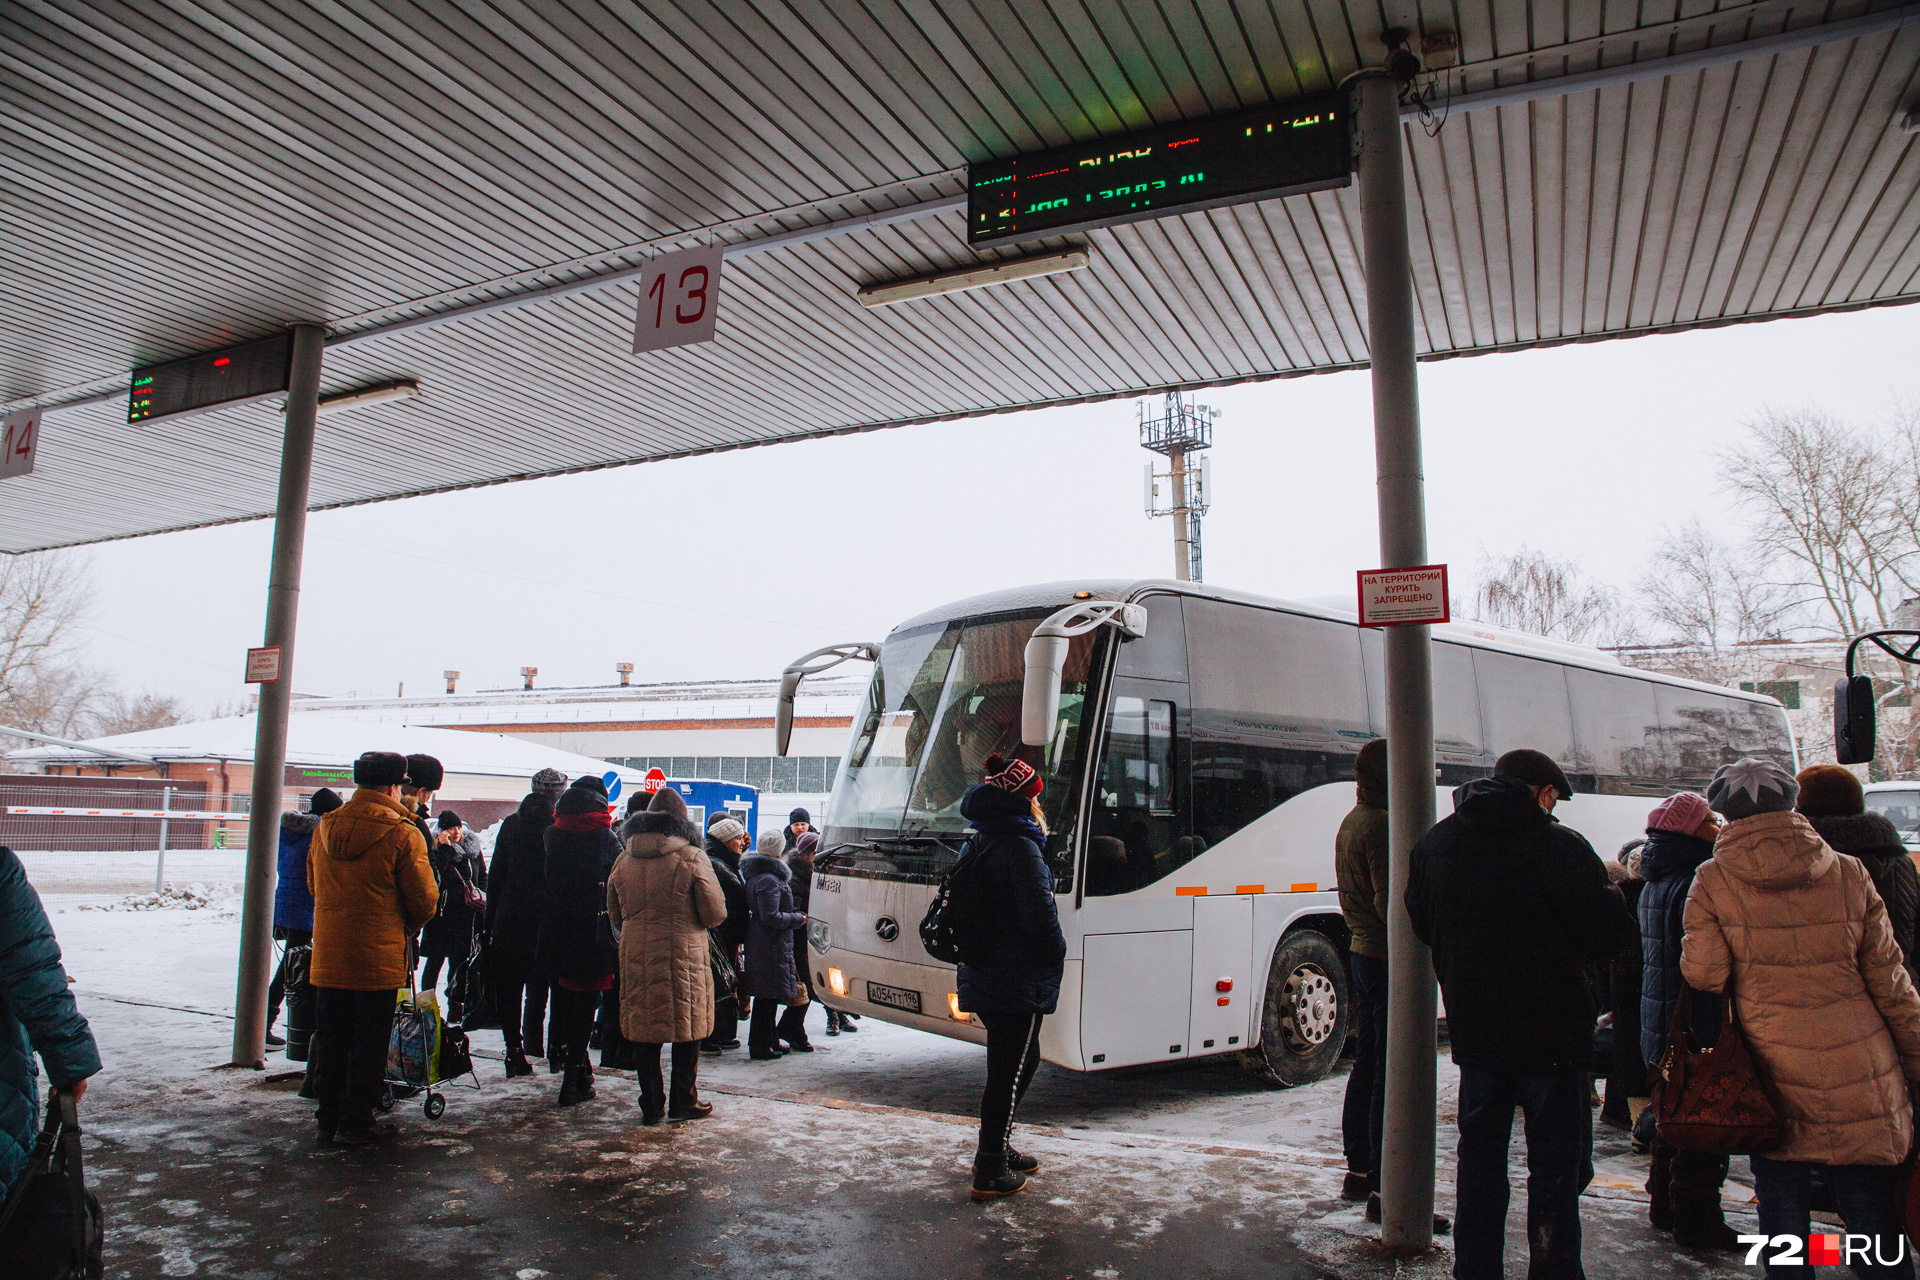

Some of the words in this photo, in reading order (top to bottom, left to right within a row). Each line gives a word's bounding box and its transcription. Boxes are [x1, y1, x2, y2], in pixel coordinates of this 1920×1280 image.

[648, 265, 709, 328] 13
[5, 420, 33, 464] 14
[1364, 577, 1378, 585] НА
[1379, 572, 1440, 584] ТЕРРИТОРИИ
[1385, 584, 1421, 594] КУРИТЬ
[1373, 593, 1433, 605] ЗАПРЕЩЕНО
[645, 779, 666, 790] STOP
